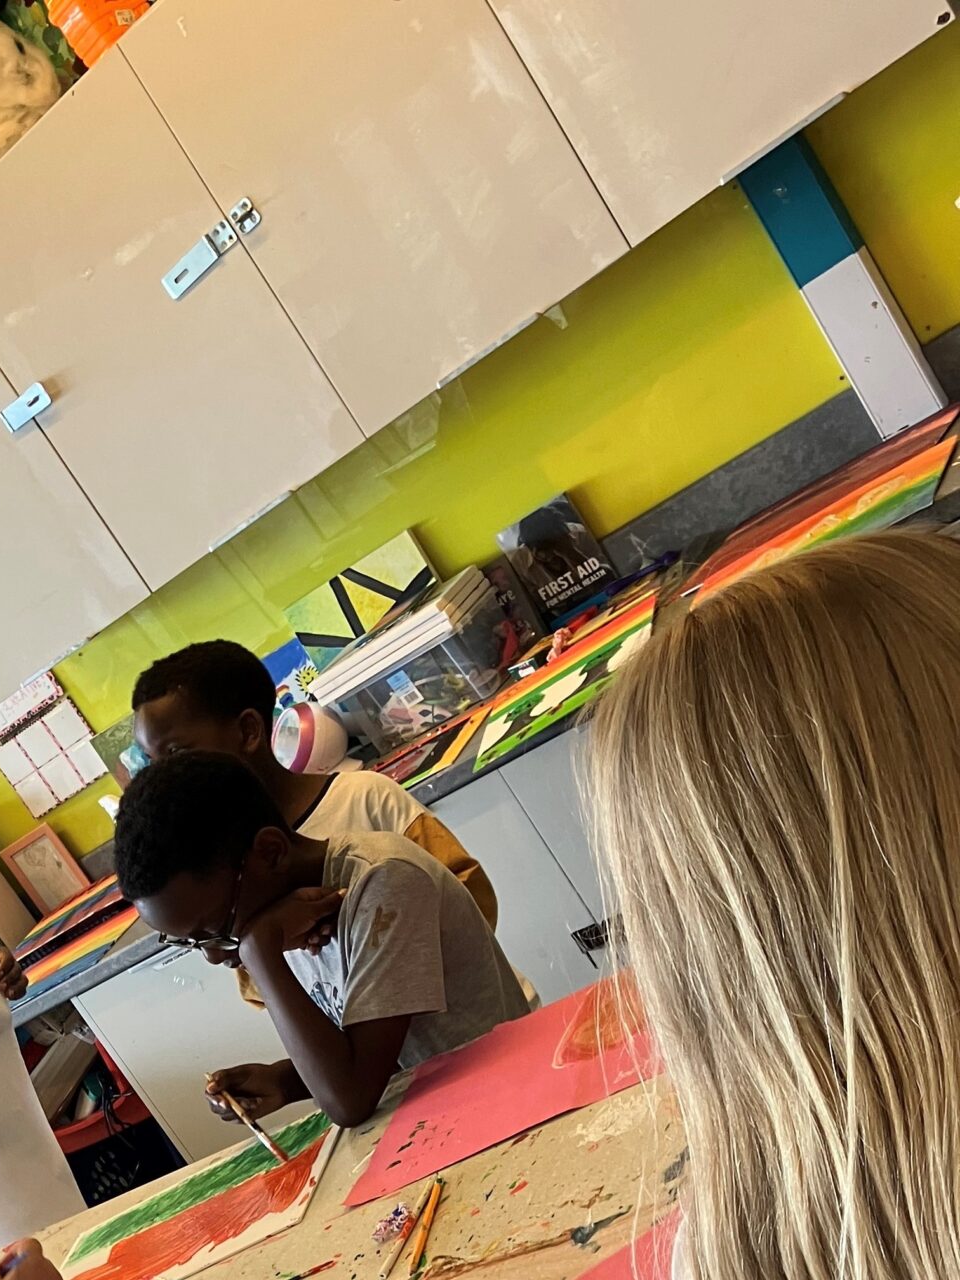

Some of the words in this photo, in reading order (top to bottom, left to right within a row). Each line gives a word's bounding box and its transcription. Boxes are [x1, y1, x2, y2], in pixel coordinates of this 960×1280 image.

[538, 571, 575, 601] FIRST
[576, 557, 601, 579] AID
[545, 597, 559, 609] FOR
[558, 583, 583, 601] MENTAL
[581, 568, 607, 587] HEALTH
